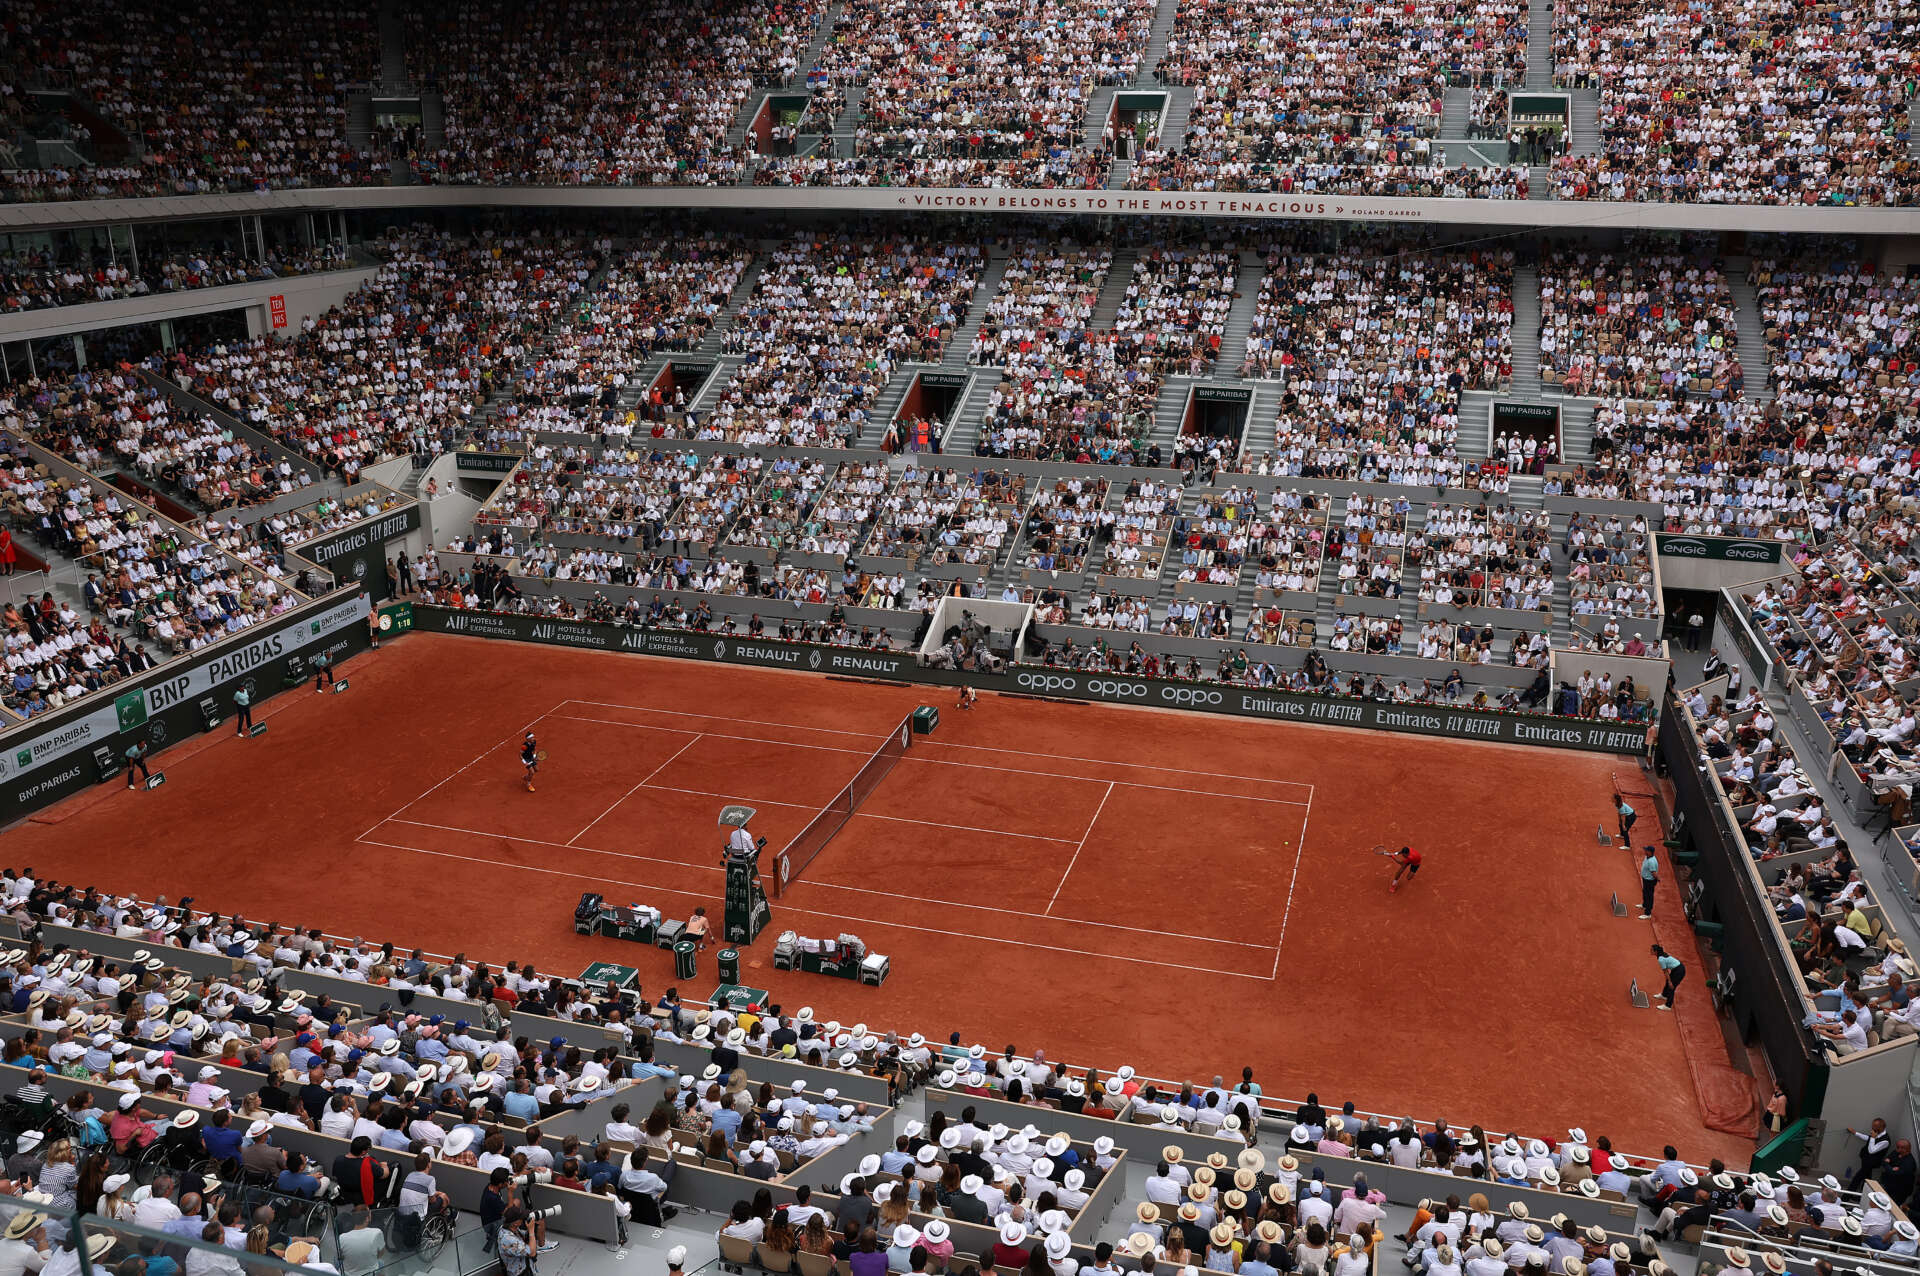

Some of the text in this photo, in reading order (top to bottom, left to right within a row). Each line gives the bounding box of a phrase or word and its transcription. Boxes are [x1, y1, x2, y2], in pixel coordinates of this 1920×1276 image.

[914, 195, 989, 206] VICTORY
[999, 196, 1077, 208] BELONGS
[1087, 198, 1107, 209] TO
[1117, 199, 1150, 210] THE
[1160, 199, 1208, 211] MOST
[1219, 200, 1326, 214] TENACIOUS
[271, 299, 283, 310] TEN
[274, 314, 285, 324] NIS
[1199, 389, 1249, 398] BNP PARIBAS
[1499, 406, 1552, 416] BNP PARIBAS
[314, 513, 408, 563] Emirates FLY BETTER
[321, 615, 333, 627] BNP
[333, 605, 357, 621] PARIBAS
[470, 617, 497, 625] HOTELS
[470, 624, 516, 635] EXPERIENCES
[558, 626, 585, 635] HOTELS
[557, 633, 606, 645] EXPERIENCES
[648, 642, 698, 654] EXPERIENCES
[649, 635, 678, 644] HOTELS
[736, 646, 801, 662] RENAULT
[149, 676, 191, 712] BNP
[208, 634, 283, 685] PARIBAS
[832, 655, 900, 673] RENAULT
[1017, 672, 1077, 692] oppo
[1087, 678, 1148, 698] oppo
[1161, 686, 1223, 706] oppo
[1242, 695, 1363, 722] Emirates FLY BETTER
[1376, 709, 1501, 736] Emirates FLY BETTER
[33, 723, 90, 755] BNP PARIBAS
[1514, 722, 1644, 750] Emirates FLY BETTER
[19, 766, 81, 802] BNP PARIBAS
[651, 1229, 664, 1239] 02
